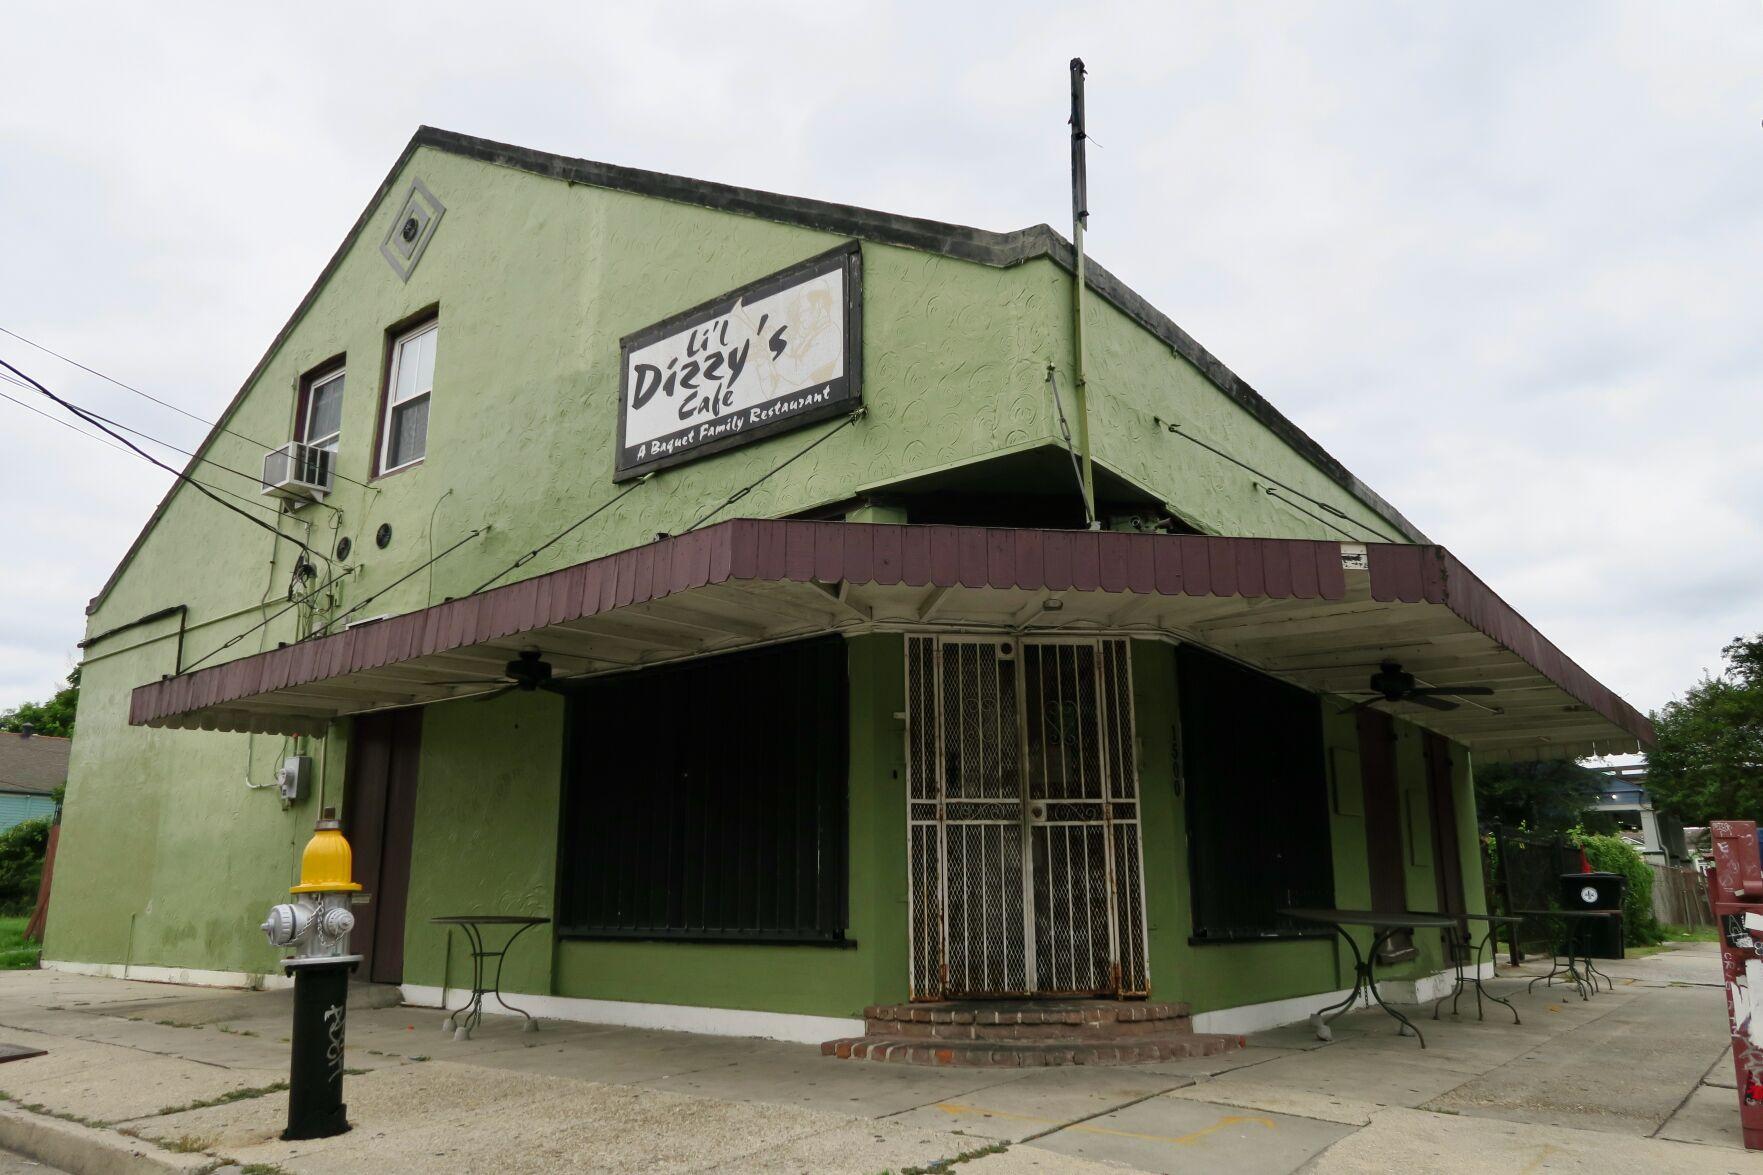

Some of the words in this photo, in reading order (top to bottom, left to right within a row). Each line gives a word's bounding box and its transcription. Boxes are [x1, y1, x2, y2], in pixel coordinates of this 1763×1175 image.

[631, 313, 788, 411] Dizzy's
[637, 444, 646, 461] A
[651, 430, 694, 455] Baquet
[699, 416, 744, 441] Family
[750, 383, 830, 424] Restaurant
[1170, 723, 1181, 798] 1500
